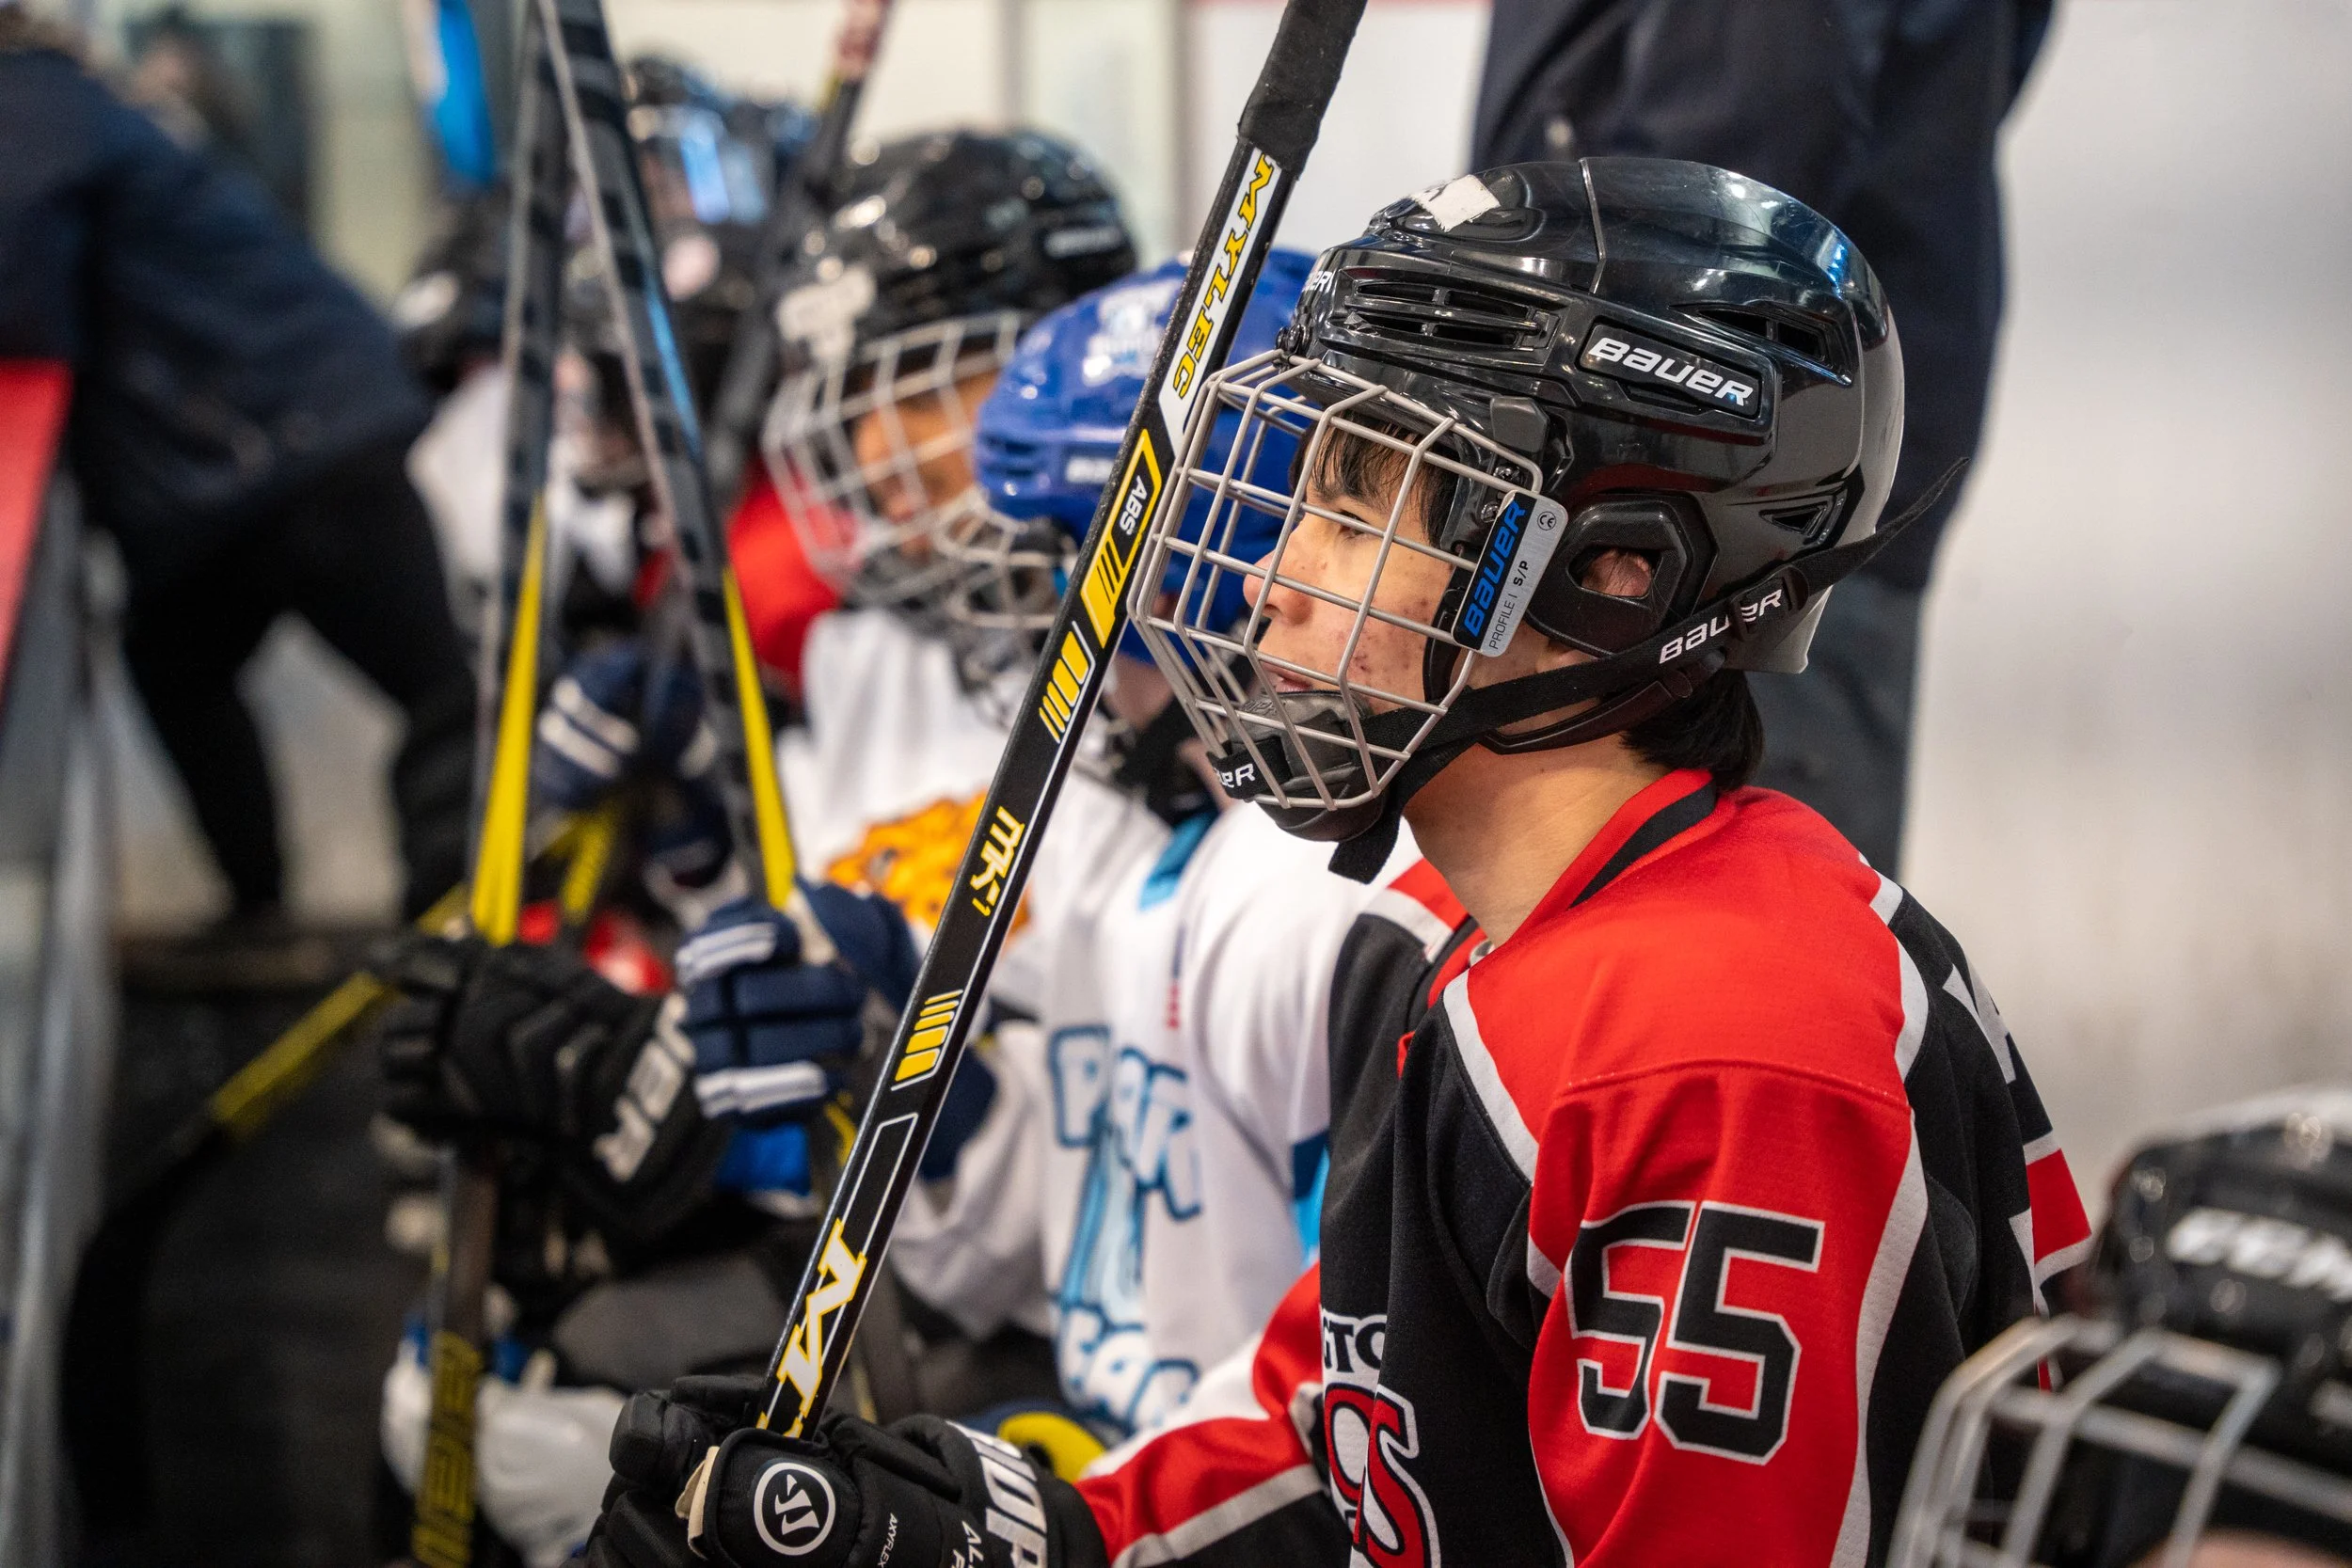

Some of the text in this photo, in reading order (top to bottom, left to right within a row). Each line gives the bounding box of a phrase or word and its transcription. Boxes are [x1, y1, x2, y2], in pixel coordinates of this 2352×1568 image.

[1172, 152, 1275, 399] MYLEC
[1120, 475, 1148, 535] ABS
[1464, 499, 1526, 638] BAUER
[1489, 600, 1517, 650] PROFILE
[1513, 560, 1529, 587] S/P
[1565, 1200, 1824, 1465] 55
